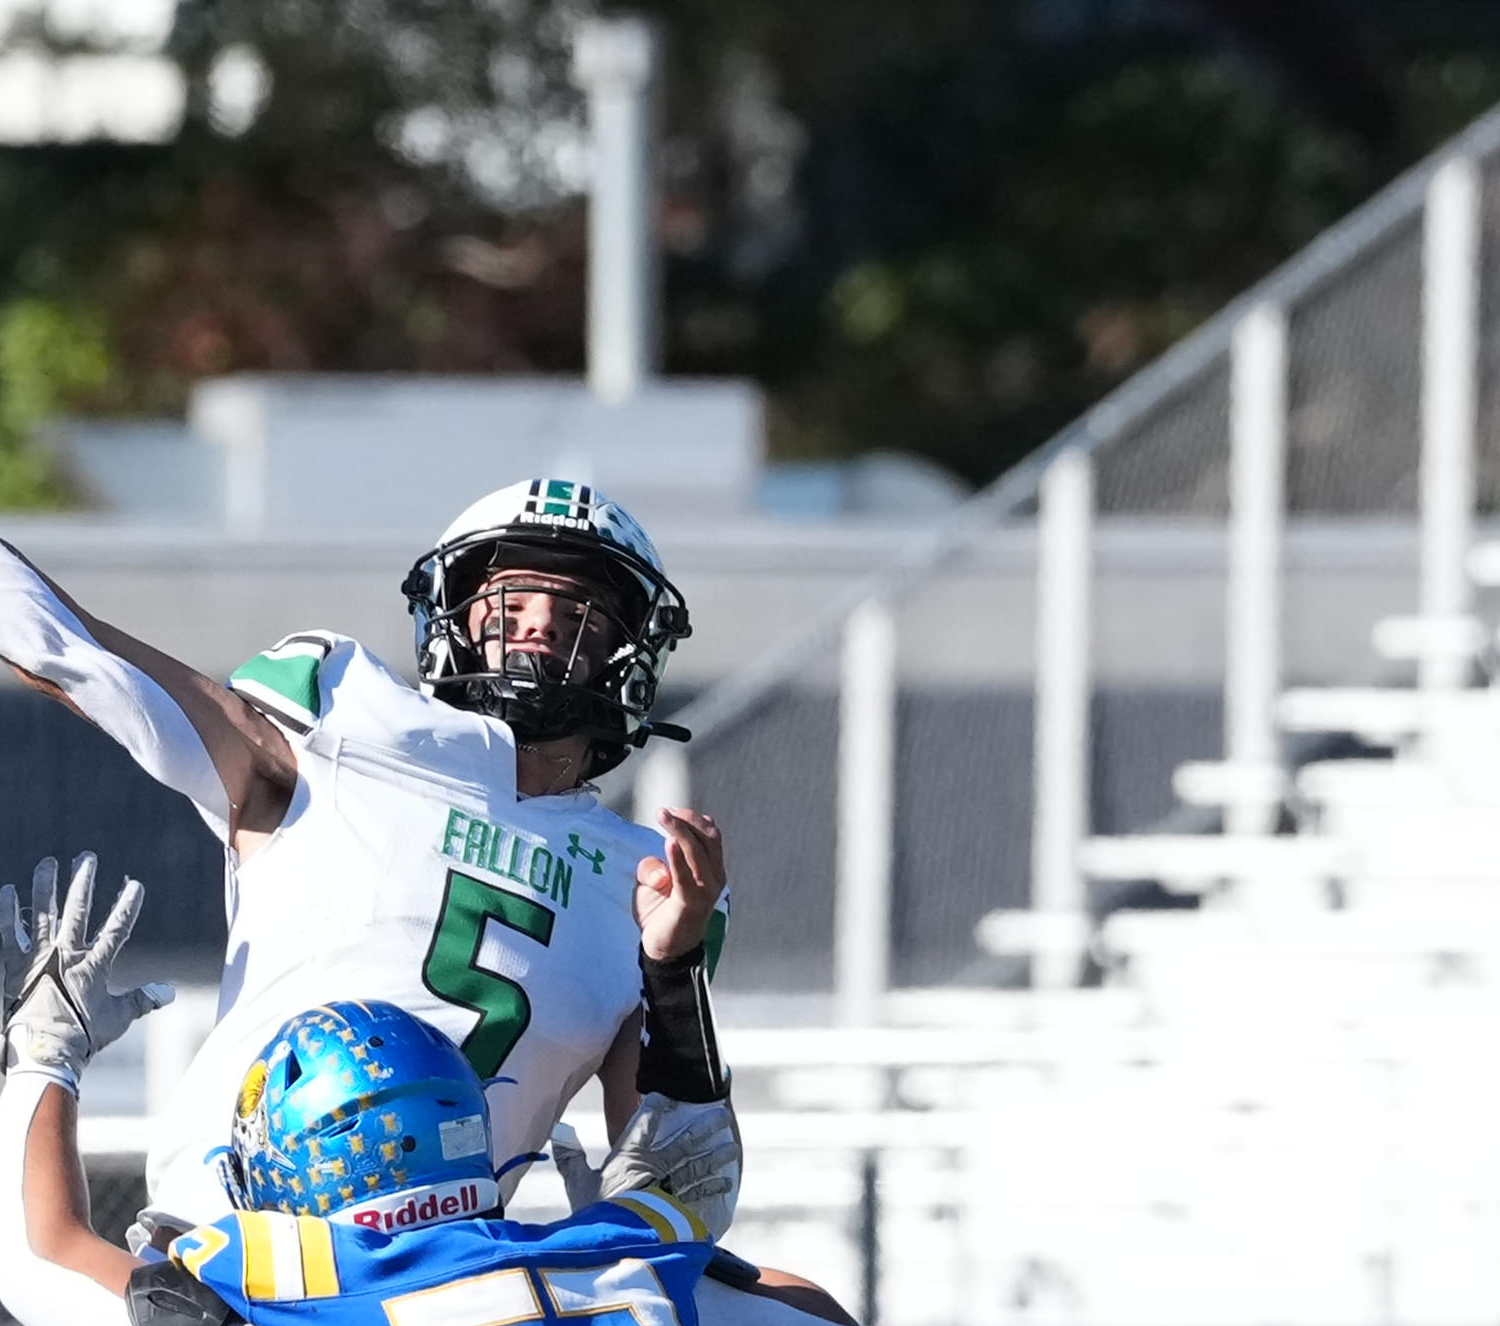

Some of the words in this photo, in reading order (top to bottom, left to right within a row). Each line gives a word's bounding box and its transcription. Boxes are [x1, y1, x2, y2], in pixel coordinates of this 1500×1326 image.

[520, 511, 590, 531] Riddell
[442, 807, 573, 910] FALLON
[421, 868, 556, 1078] 5
[354, 1184, 478, 1231] Riddell
